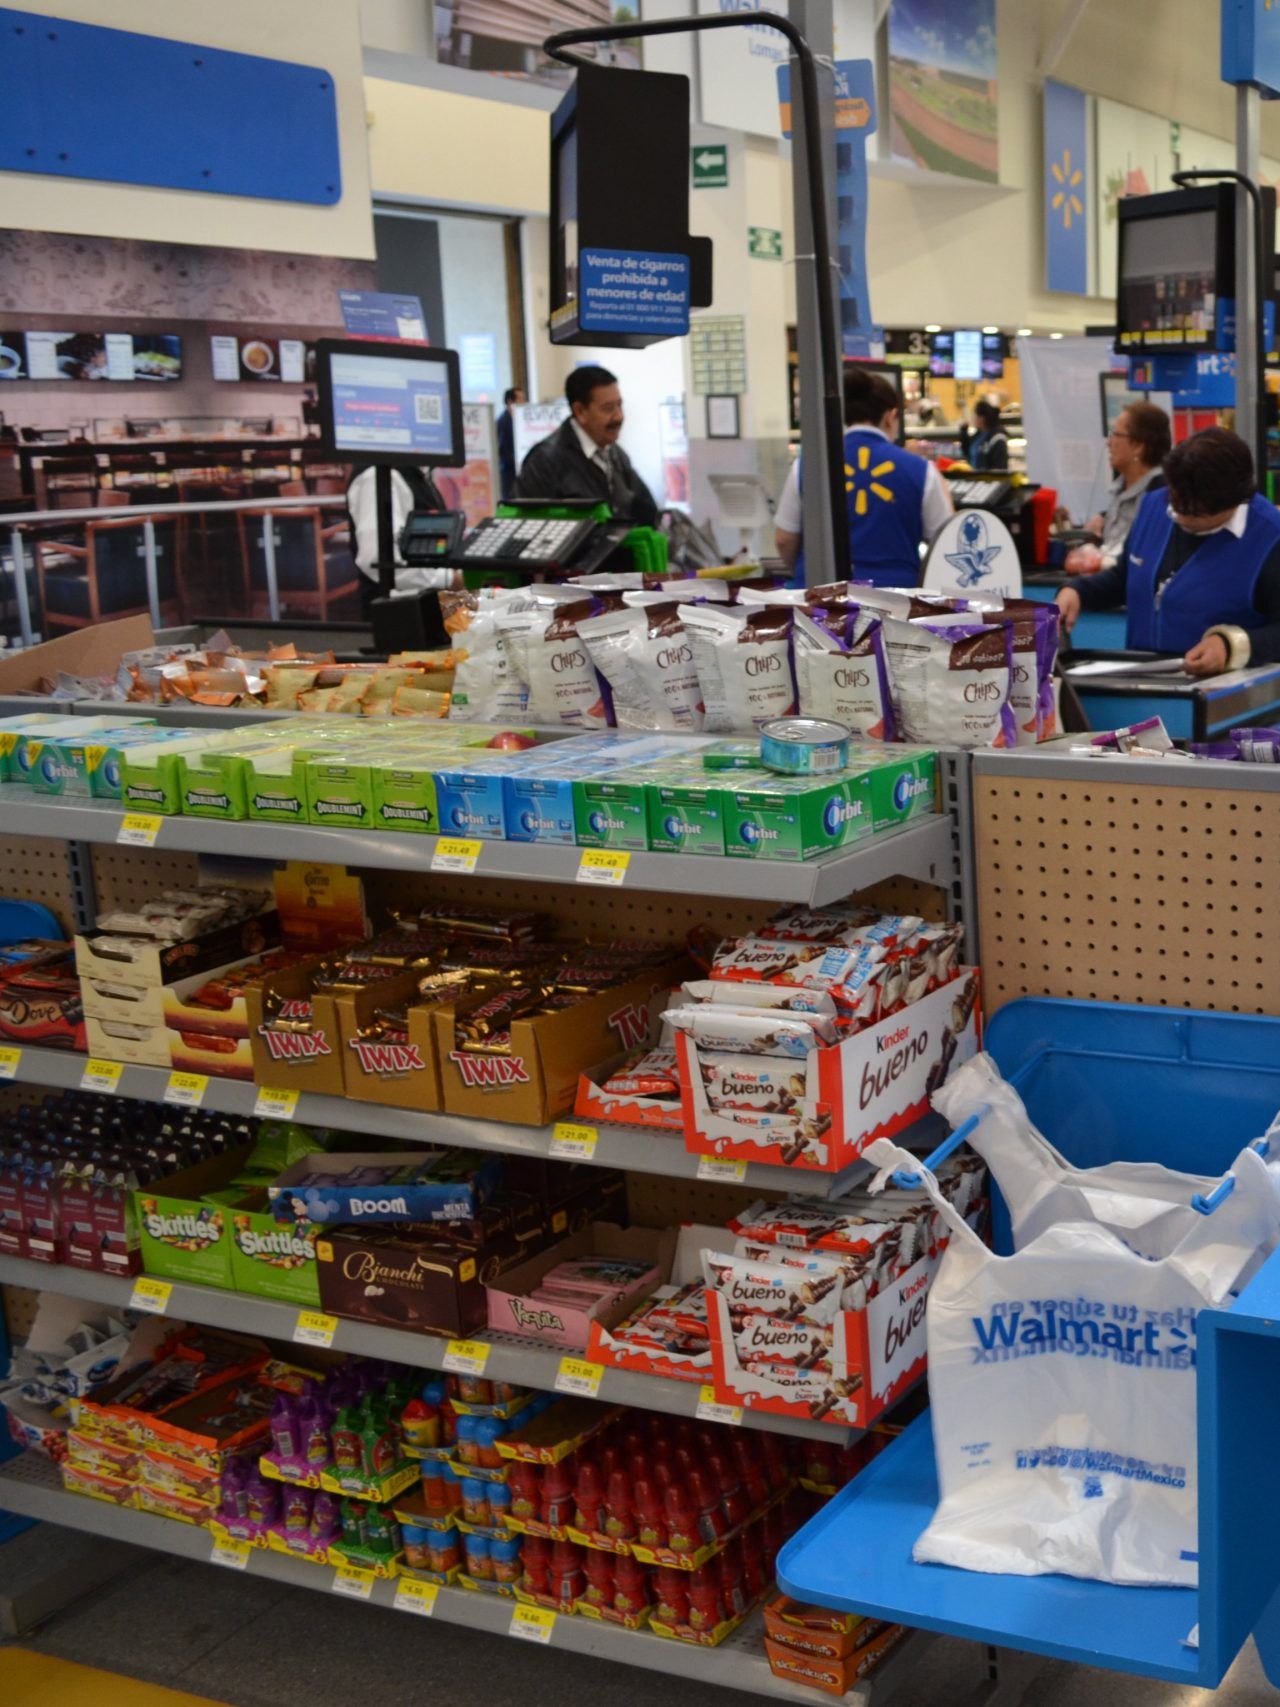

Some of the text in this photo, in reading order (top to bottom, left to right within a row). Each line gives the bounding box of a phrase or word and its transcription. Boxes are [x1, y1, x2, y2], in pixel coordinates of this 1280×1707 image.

[586, 254, 686, 273] Venta de cigarros
[602, 272, 668, 286] prohibida a
[586, 287, 686, 302] menores de edad
[551, 649, 586, 673] Chips
[657, 644, 693, 669] Chips
[745, 652, 782, 676] Chips
[834, 668, 870, 689] Chips
[963, 681, 1001, 703] Chips
[256, 796, 299, 812] DOUBLEMINT
[317, 801, 362, 817] DOUBLEMINT
[383, 806, 429, 822] DOUBLEMINT
[735, 949, 786, 963] bueno
[12, 999, 56, 1025] Dove
[259, 1024, 331, 1059] TWIX
[350, 1038, 426, 1073] TWIX
[451, 1051, 529, 1086] TWIX
[860, 1029, 928, 1111] bueno
[722, 1078, 775, 1096] bueno
[350, 1197, 408, 1215] BOOM
[148, 1214, 220, 1242] Skittles
[240, 1231, 316, 1259] Skittles
[343, 1251, 424, 1284] Bianchi
[732, 1282, 786, 1300] bueno
[752, 1326, 808, 1346] bueno
[972, 1310, 1160, 1356] Walmart
